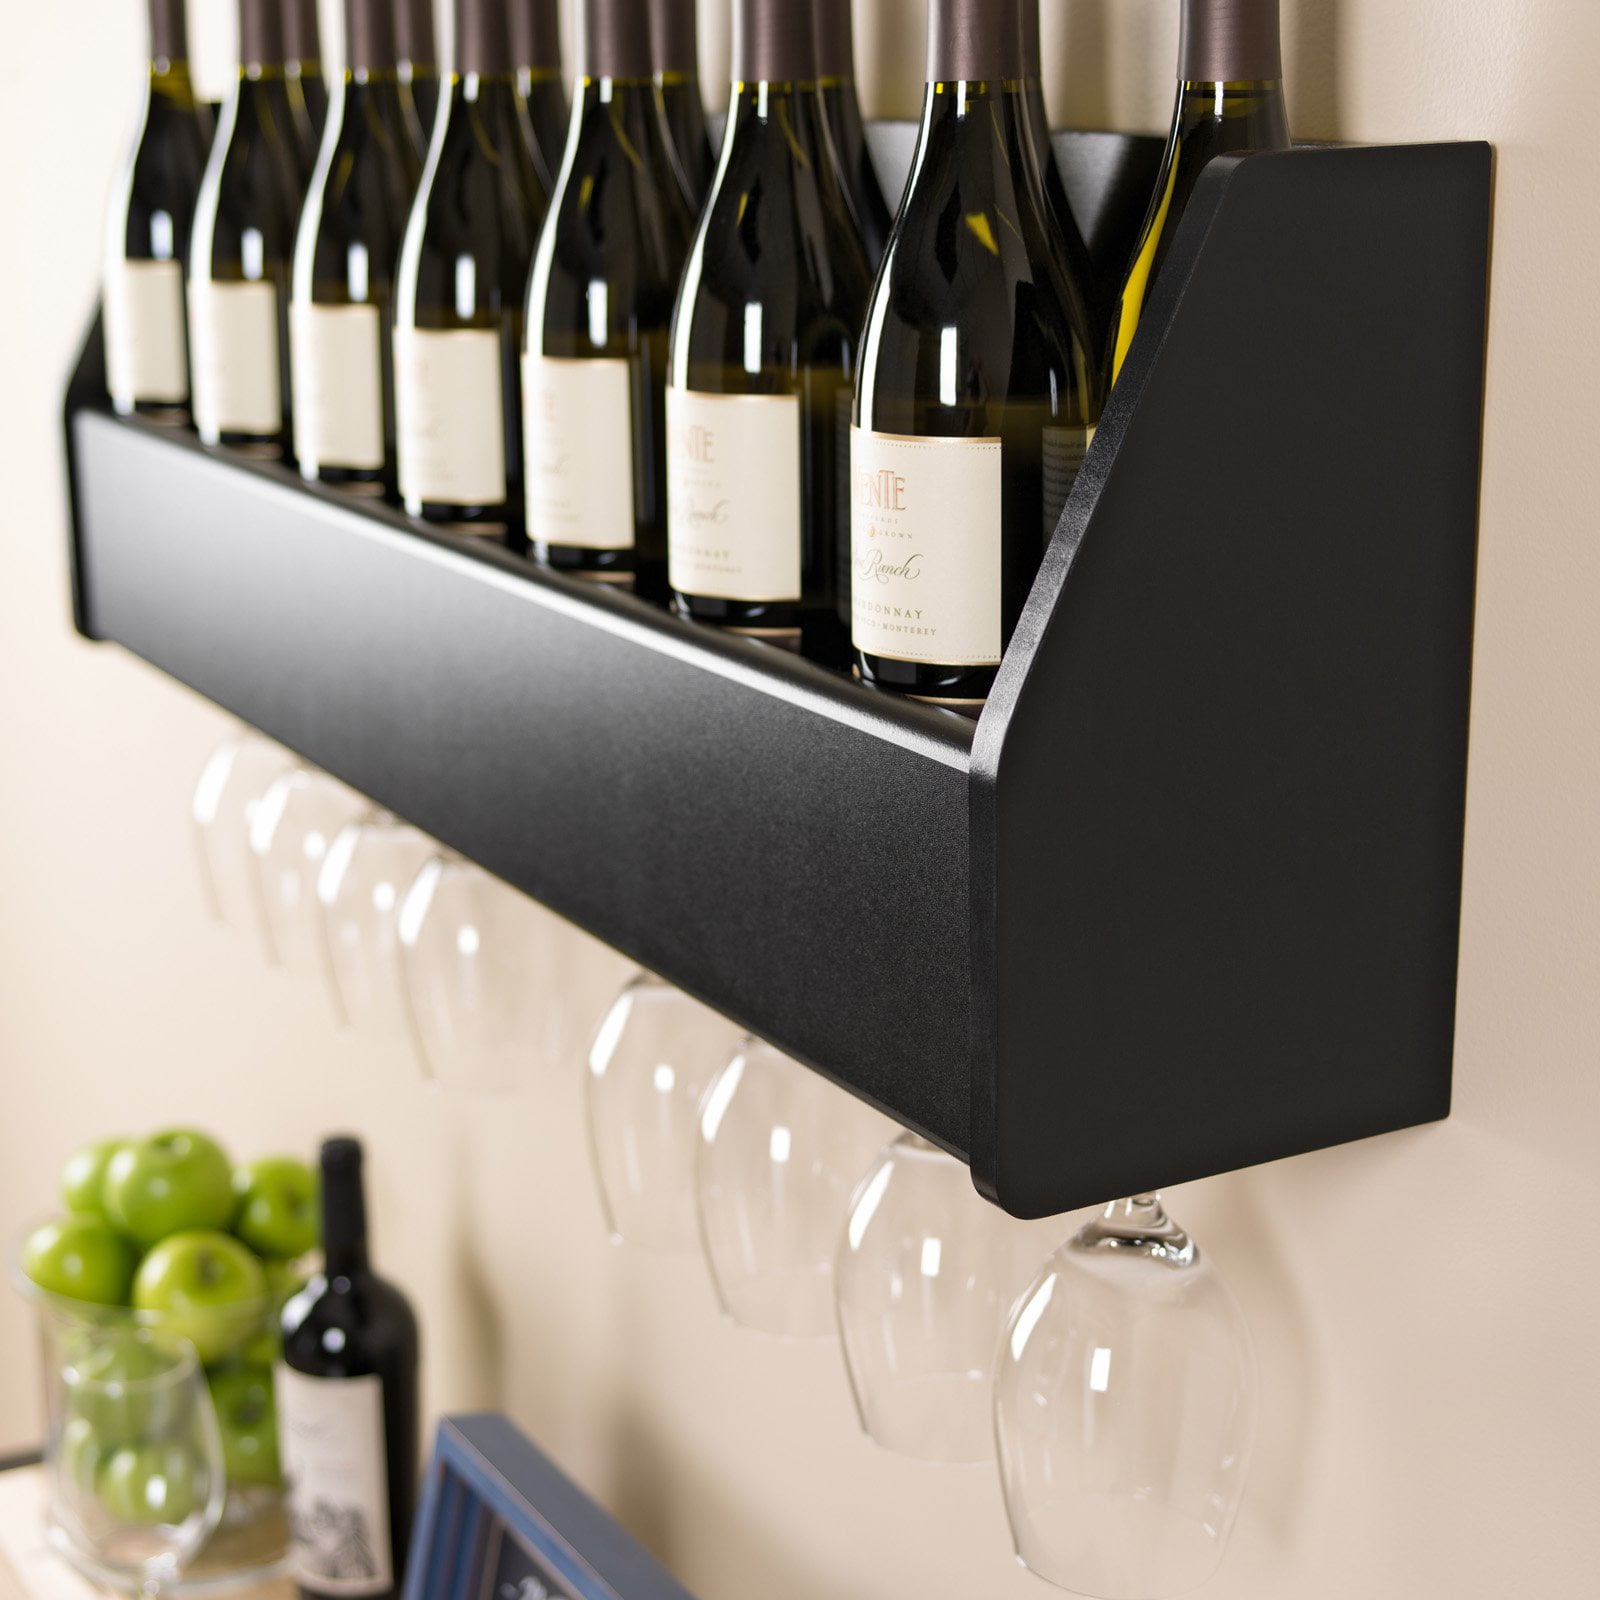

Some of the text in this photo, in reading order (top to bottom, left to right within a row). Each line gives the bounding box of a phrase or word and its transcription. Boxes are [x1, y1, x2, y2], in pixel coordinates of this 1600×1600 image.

[858, 468, 908, 511] ENTE
[859, 548, 924, 585] Ranch
[882, 622, 937, 636] MONTEREY
